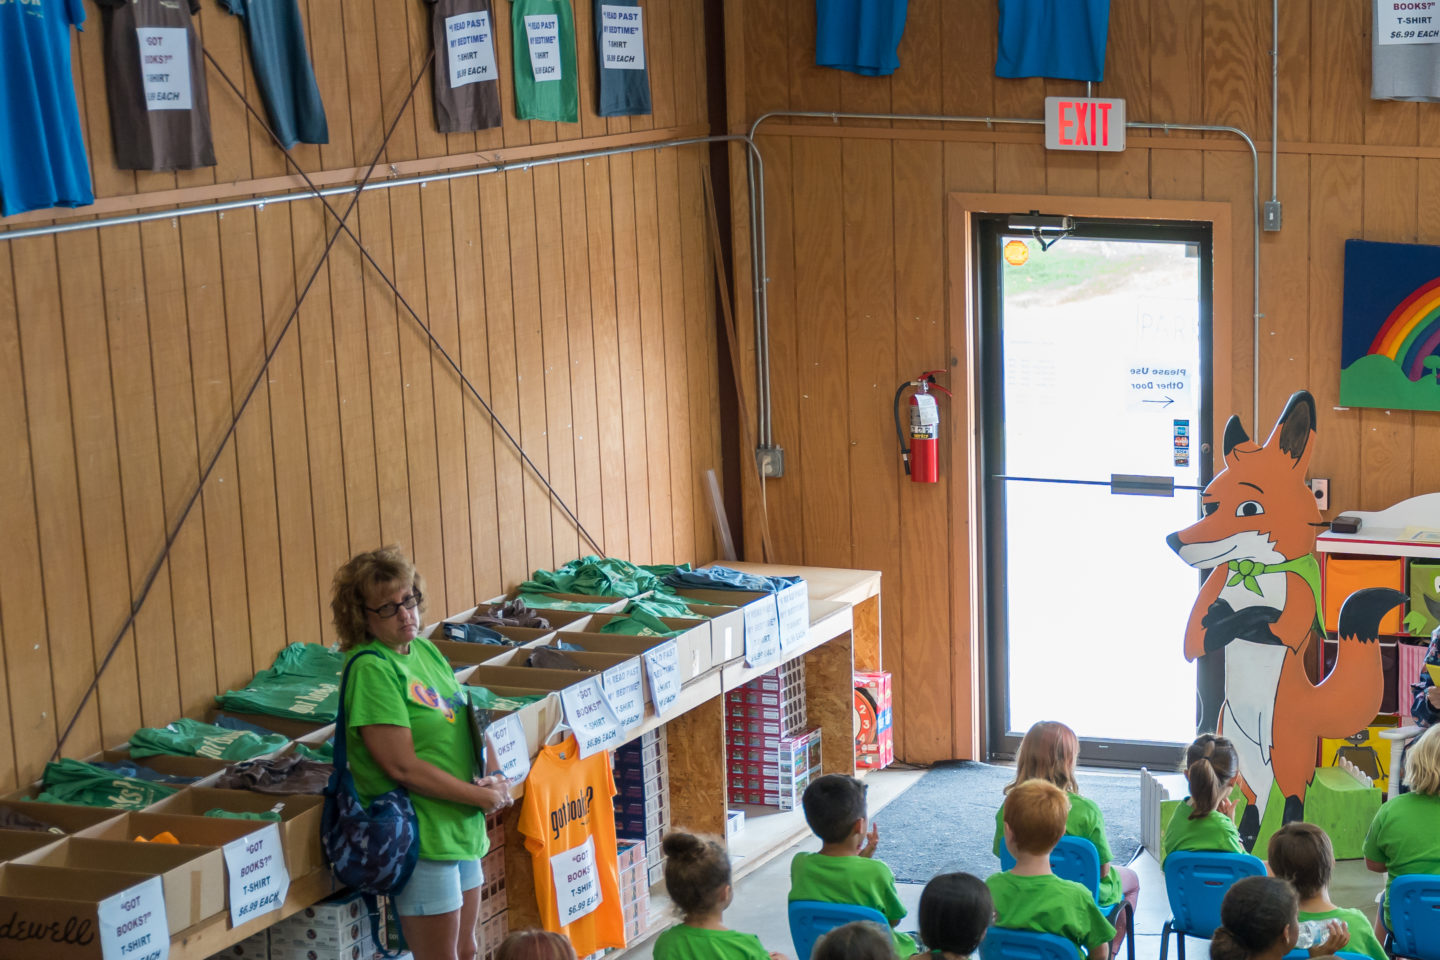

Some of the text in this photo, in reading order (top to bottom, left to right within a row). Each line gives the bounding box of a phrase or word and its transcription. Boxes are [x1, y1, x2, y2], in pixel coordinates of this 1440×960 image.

[1393, 2, 1436, 11] BOOKS?"
[618, 12, 639, 21] PAST
[1397, 16, 1433, 25] T-SHIRT
[466, 18, 486, 28] PAST
[540, 21, 556, 30] PAST
[1390, 30, 1440, 39] $6.99 EACH
[616, 55, 635, 63] EACH
[467, 65, 487, 76] EACH
[542, 66, 555, 74] EACH
[157, 91, 180, 101] EACH
[1058, 101, 1113, 147] EXIT
[859, 705, 866, 715] 2
[863, 720, 870, 729] 3
[602, 729, 617, 742] EACH
[246, 840, 263, 855] "GOT
[241, 855, 272, 877] BOOKS?"
[243, 876, 270, 895] T-SHIRT
[121, 896, 141, 912] "GOT
[239, 891, 280, 917] $6.99 EACH
[568, 901, 585, 915] $6.99
[116, 912, 152, 937] BOOKS?"
[121, 933, 151, 955] T-SHIRT
